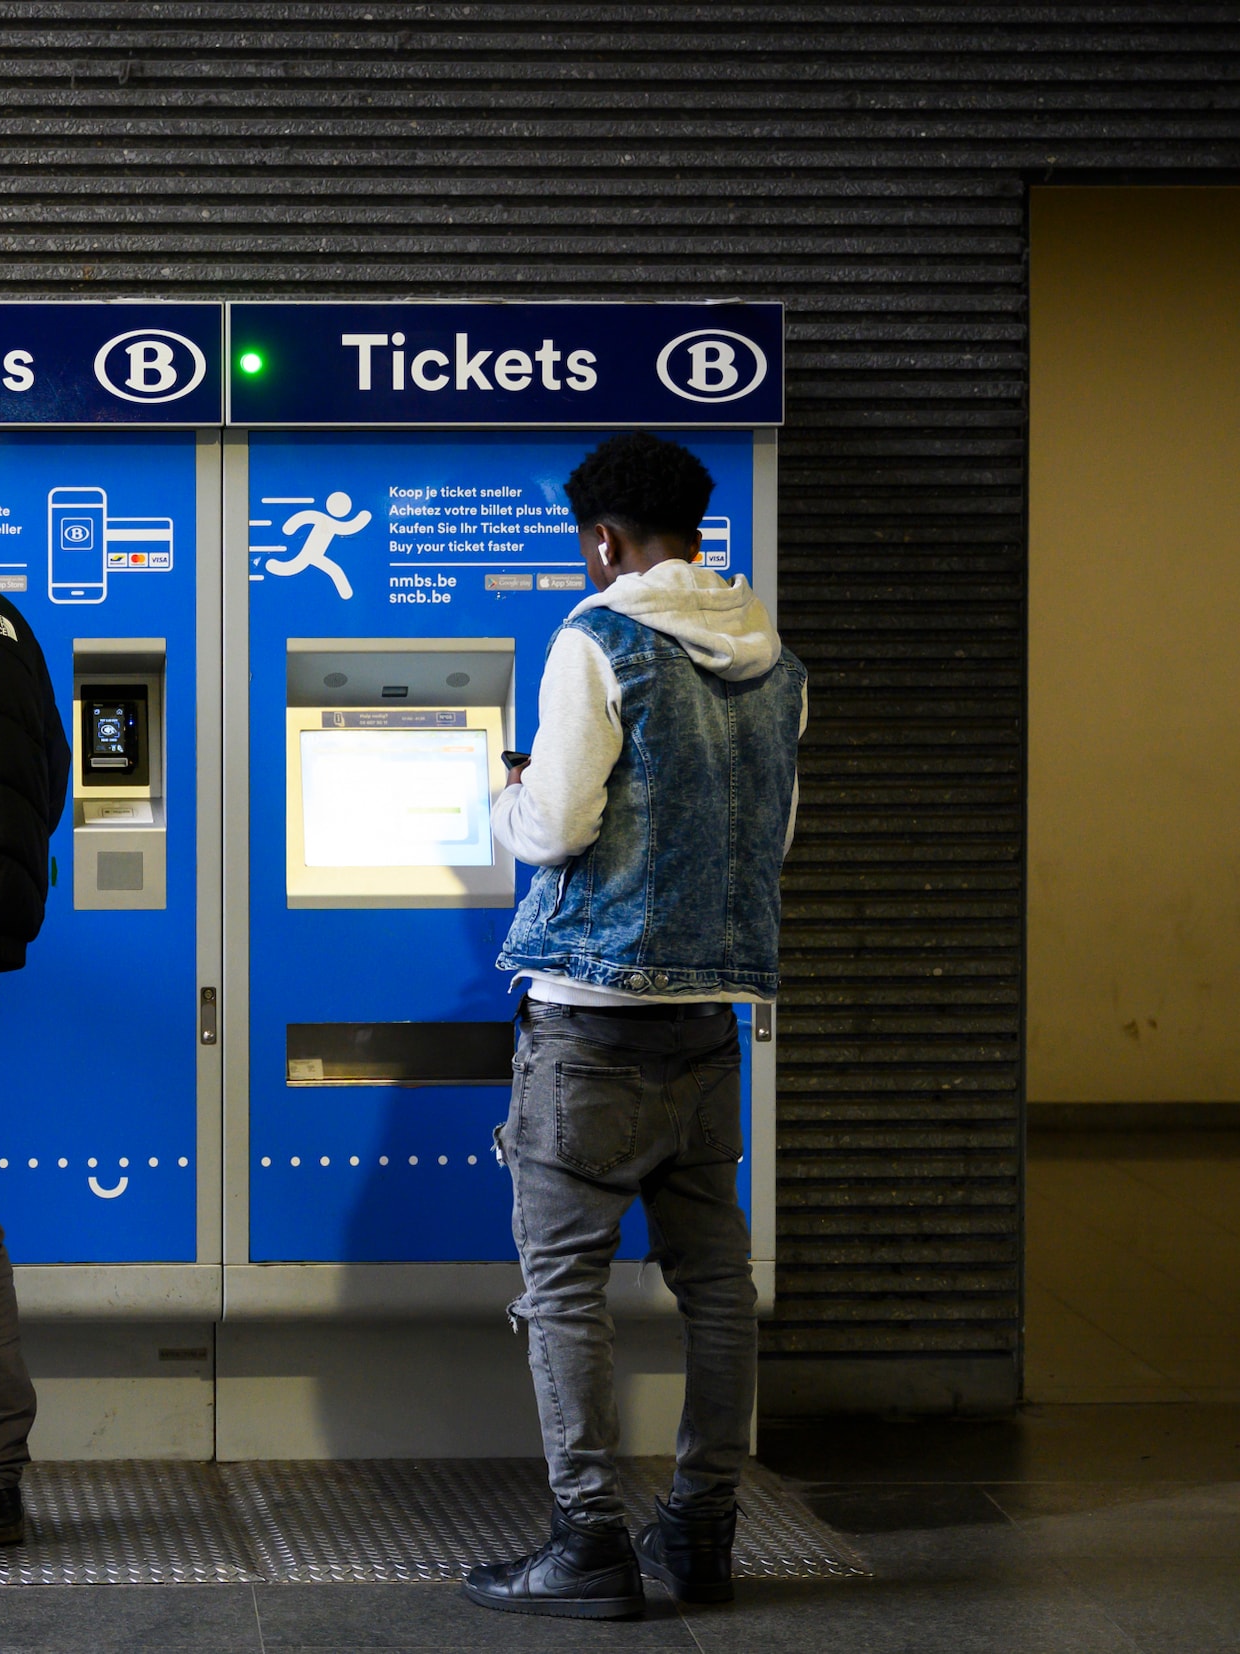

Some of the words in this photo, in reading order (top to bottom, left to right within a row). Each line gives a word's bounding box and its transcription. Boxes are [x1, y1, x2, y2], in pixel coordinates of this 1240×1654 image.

[342, 332, 598, 391] Tickets
[390, 487, 423, 500] Koop
[425, 486, 437, 500] je
[440, 486, 477, 498] ticket
[480, 486, 522, 498] sneller
[389, 504, 441, 516] Achetez
[444, 506, 477, 516] votre
[481, 505, 512, 516] billet
[516, 505, 542, 518] plus
[545, 504, 569, 516] vite
[390, 523, 434, 534] Kaufen
[437, 523, 457, 534] Sie
[461, 523, 477, 534] Ihr
[481, 523, 520, 534] Ticket
[390, 541, 413, 554] Buy
[416, 544, 445, 554] your
[448, 541, 485, 552] ticket
[488, 541, 525, 552] faster
[389, 574, 457, 588] nmbs.be
[499, 580, 518, 588] Google
[551, 580, 565, 588] App
[389, 590, 452, 604] sncb.be
